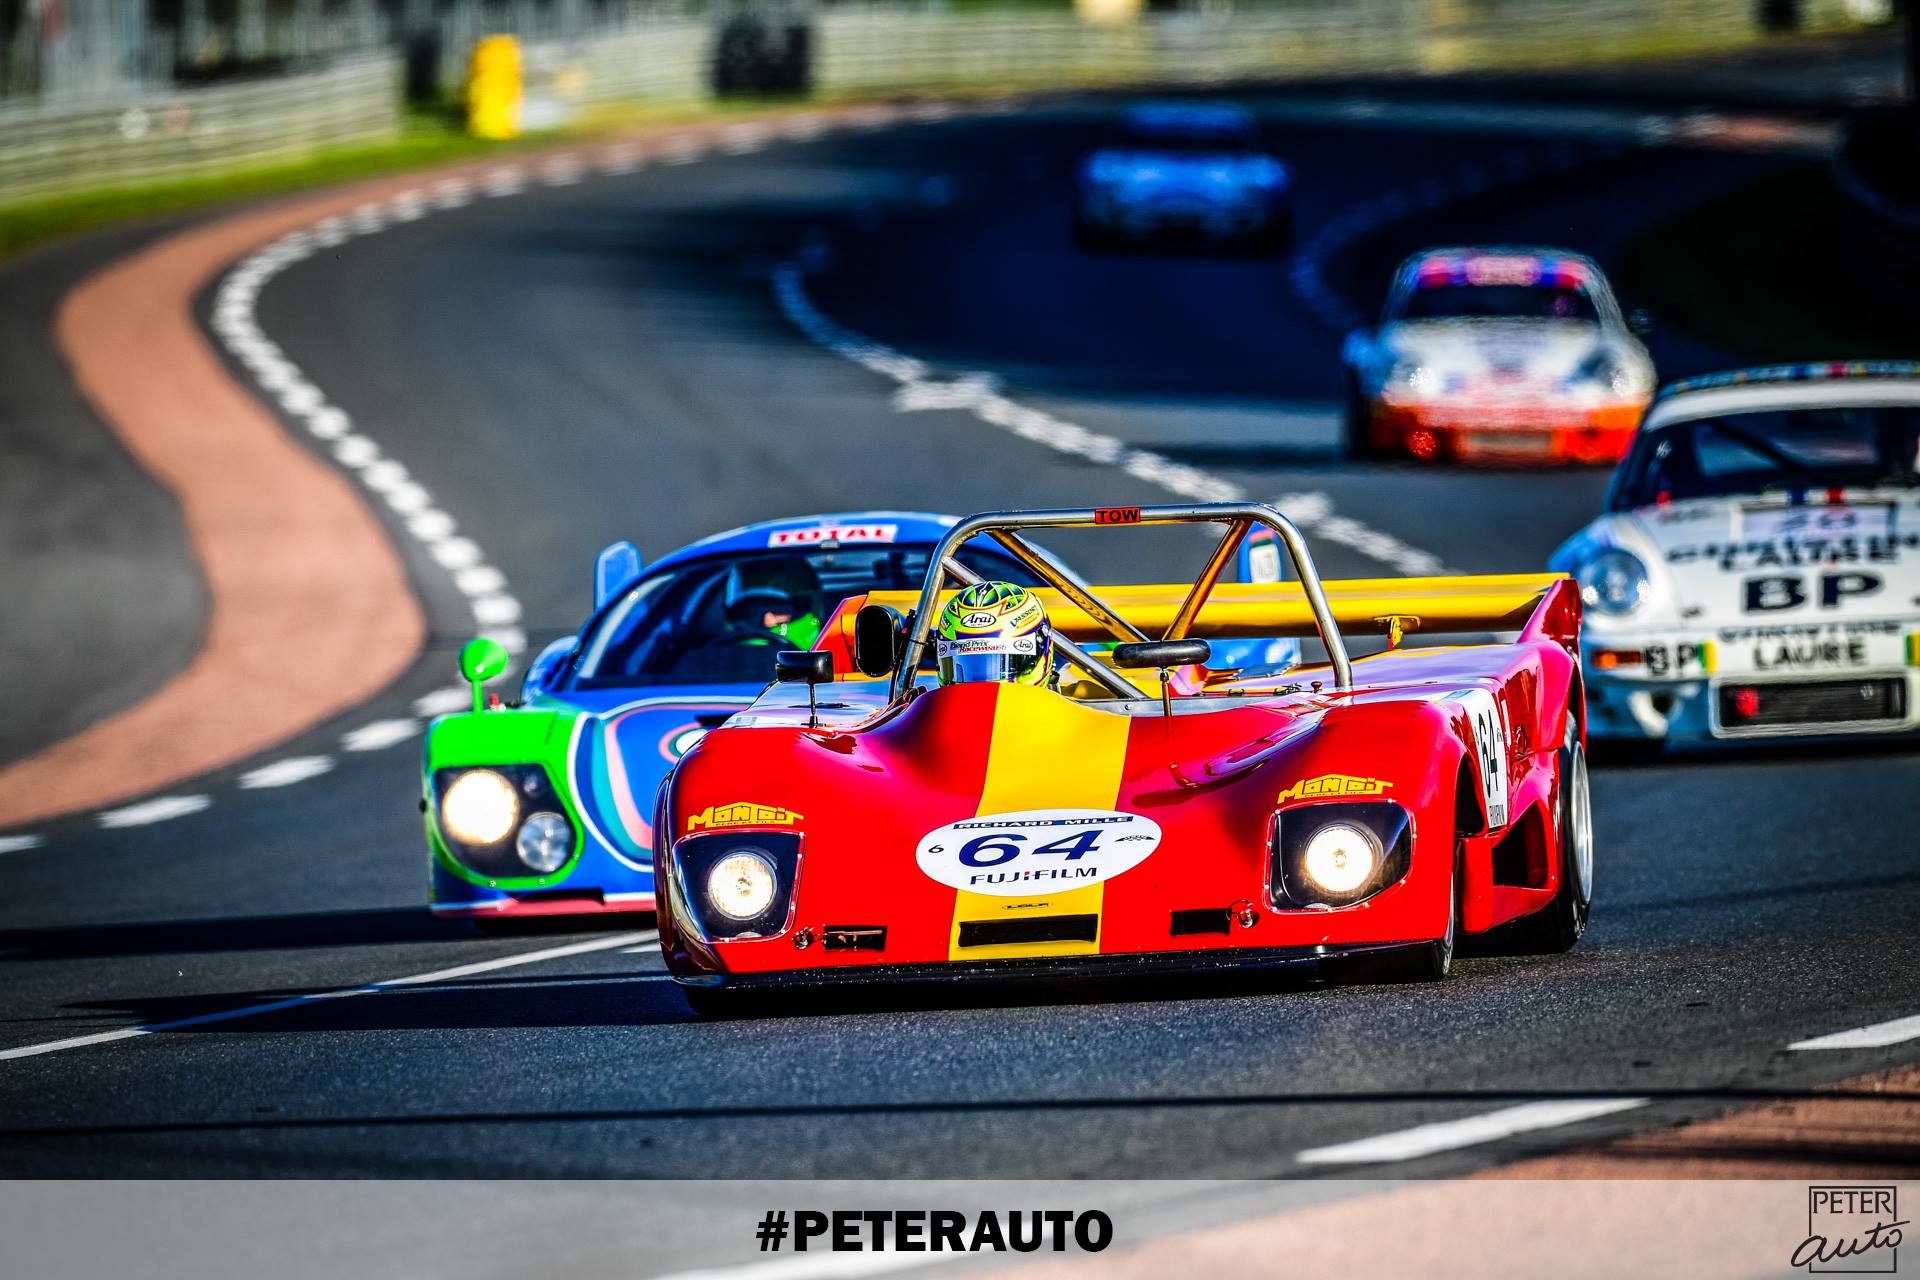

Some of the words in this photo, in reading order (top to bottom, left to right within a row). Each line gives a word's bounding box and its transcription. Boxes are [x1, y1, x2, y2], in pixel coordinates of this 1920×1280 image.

[1096, 508, 1139, 523] TOW
[776, 527, 889, 544] TOTAL
[1742, 573, 1884, 614] BP
[964, 614, 992, 625] Arai
[1016, 640, 1032, 649] Arai
[1754, 636, 1866, 669] LAURE
[1645, 643, 1698, 675] BP
[1478, 709, 1499, 799] 64
[958, 819, 1054, 830] RICHARD
[1064, 816, 1128, 825] MILLE
[928, 844, 945, 854] 6
[958, 829, 1105, 867] 64
[969, 867, 1098, 885] FUJIFILM
